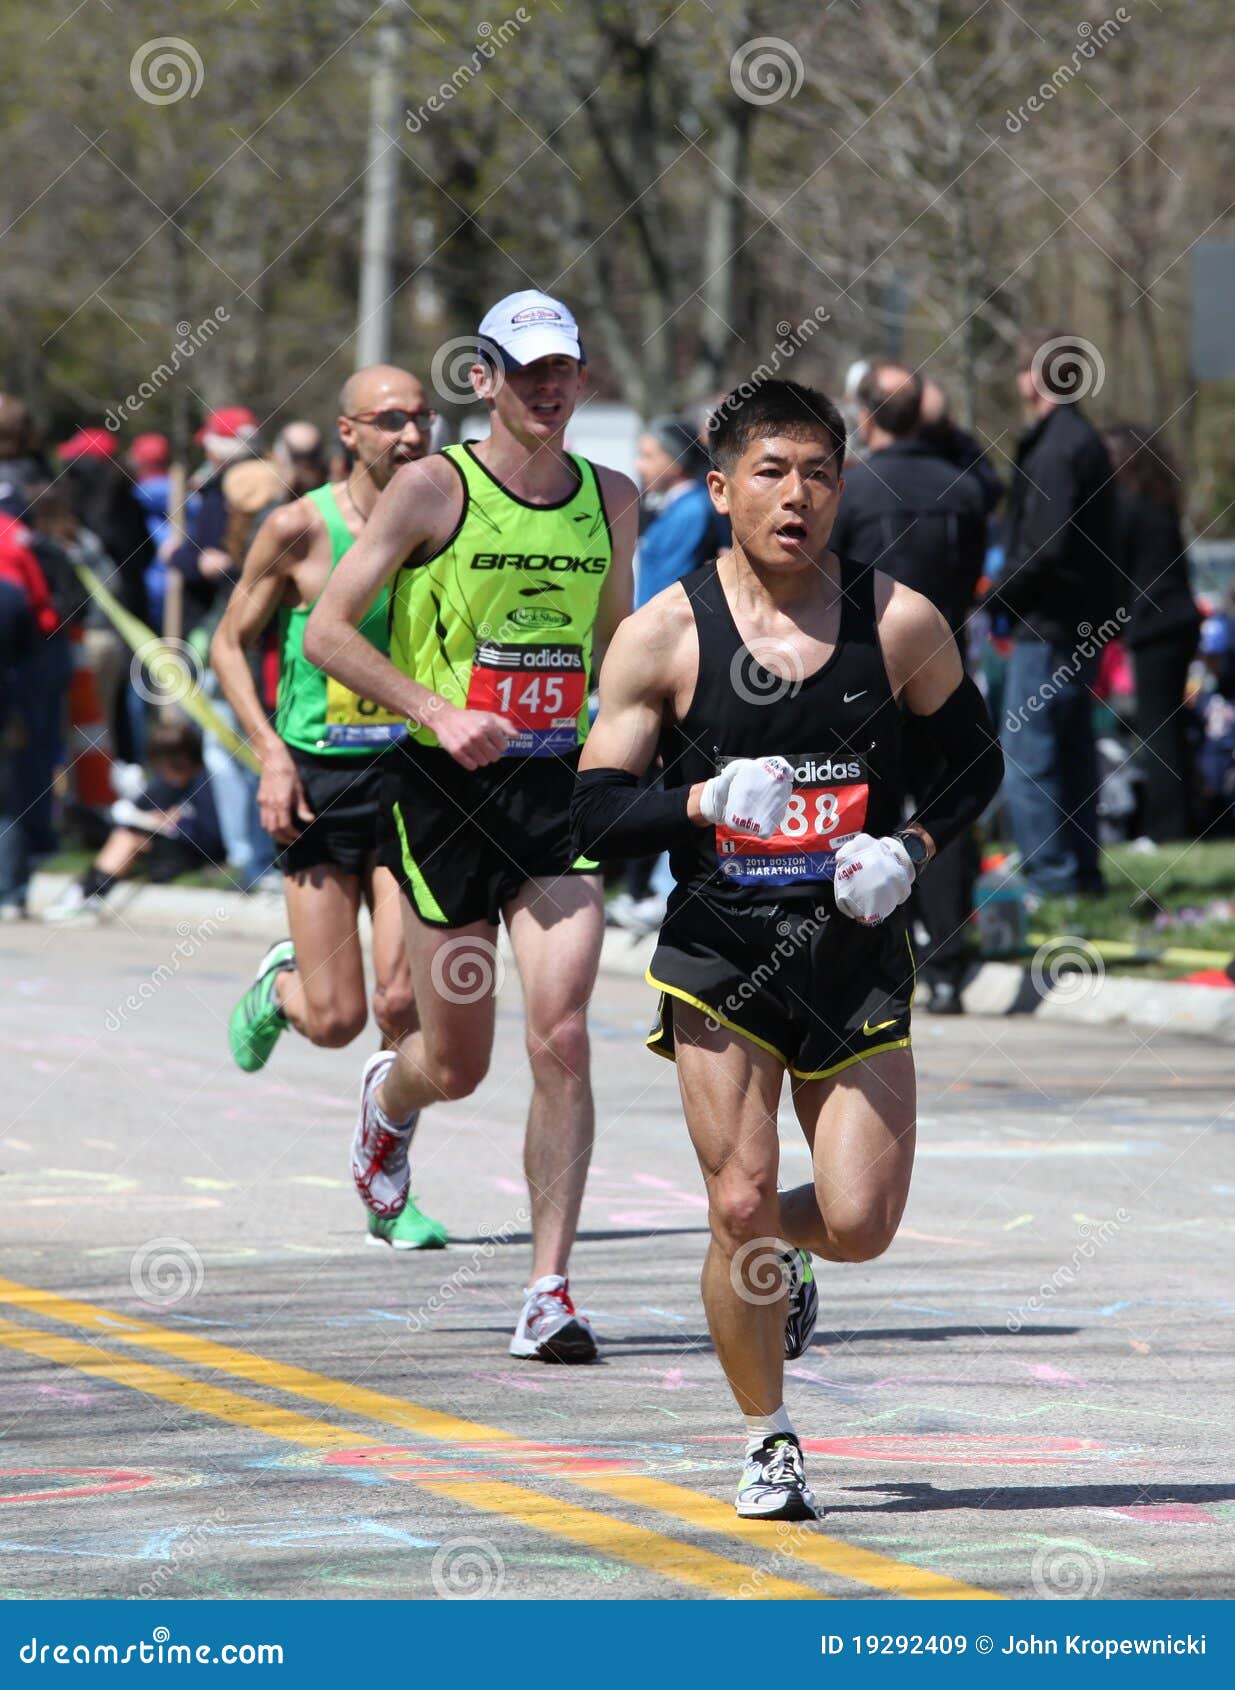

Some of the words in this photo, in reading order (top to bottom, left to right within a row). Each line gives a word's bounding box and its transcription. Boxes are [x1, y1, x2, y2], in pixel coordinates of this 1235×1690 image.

[470, 553, 607, 574] BROOKS
[523, 649, 582, 668] adidas
[496, 676, 564, 714] 145
[794, 759, 862, 782] didas
[780, 793, 840, 837] 88
[725, 841, 732, 852] 1
[746, 858, 766, 866] 2011
[769, 856, 806, 866] BOSTON
[746, 865, 807, 876] MARATHON
